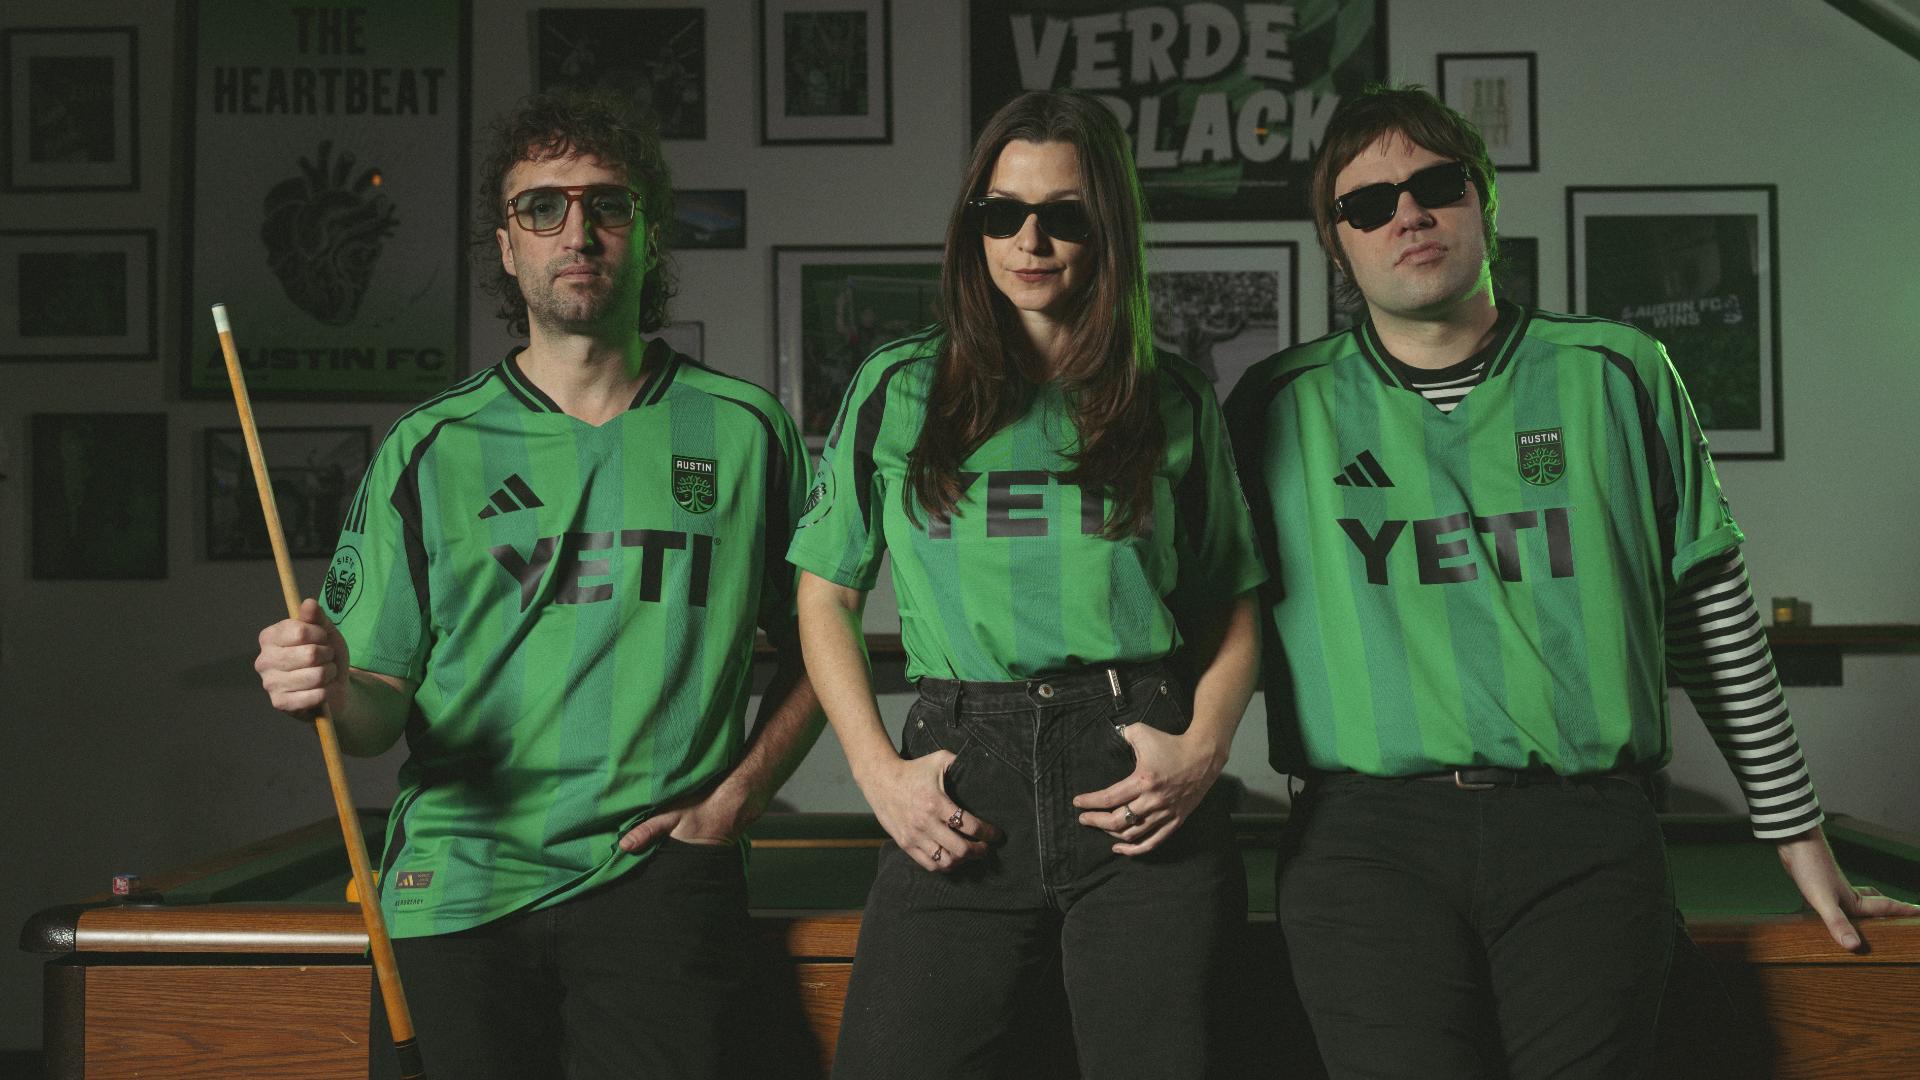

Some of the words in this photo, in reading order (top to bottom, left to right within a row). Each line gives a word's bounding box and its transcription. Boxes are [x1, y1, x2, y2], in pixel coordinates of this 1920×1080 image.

[292, 8, 366, 54] THE
[1009, 3, 1297, 92] VERDE
[214, 66, 445, 115] HEARTBEAT
[387, 347, 446, 370] FC
[1520, 432, 1558, 445] AUSTIN
[676, 460, 712, 472] AUSTIN
[926, 470, 1153, 539] ET
[489, 529, 714, 613] YETI
[1336, 507, 1575, 586] YETI
